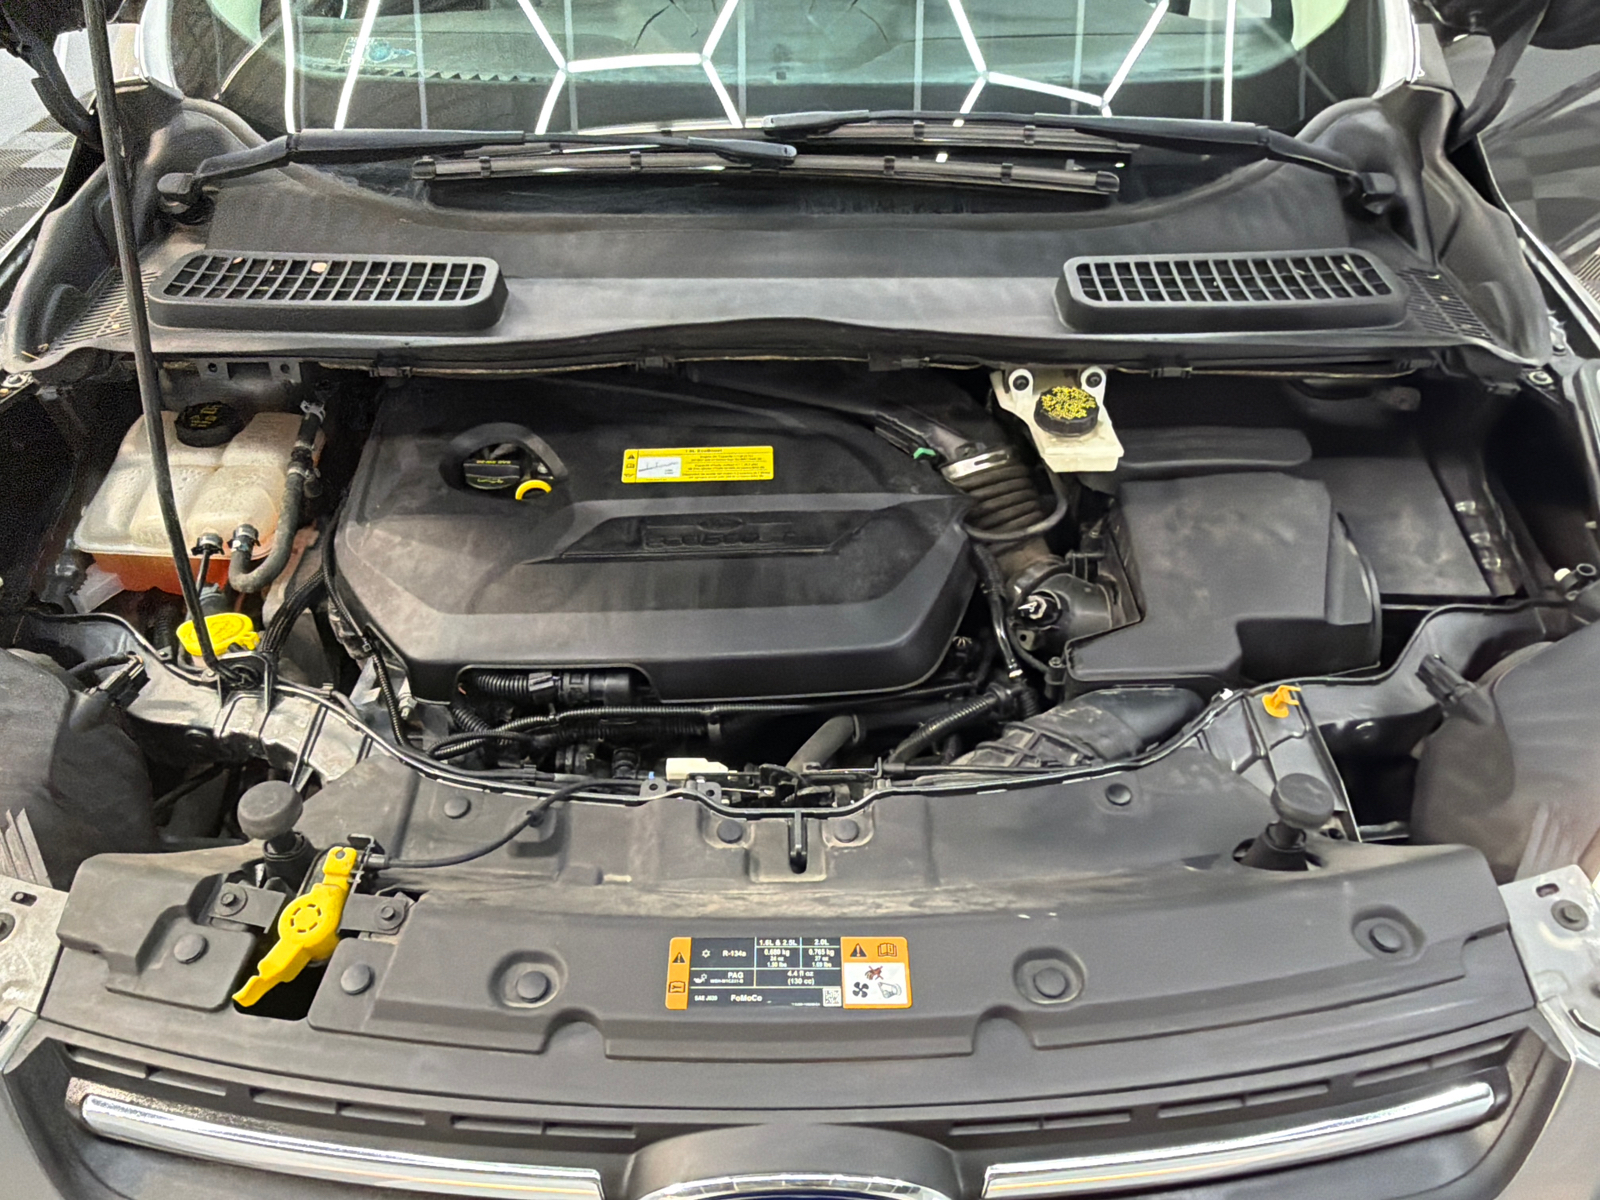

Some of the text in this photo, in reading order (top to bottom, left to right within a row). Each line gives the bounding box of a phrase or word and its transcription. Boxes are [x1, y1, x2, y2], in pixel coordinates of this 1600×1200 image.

[814, 938, 830, 946] 2.0L
[722, 949, 747, 957] R-134a
[782, 948, 790, 957] kg
[808, 948, 835, 957] 0.765 kg
[787, 977, 815, 986] (130 cc)
[730, 994, 763, 1002] FoMoCo
